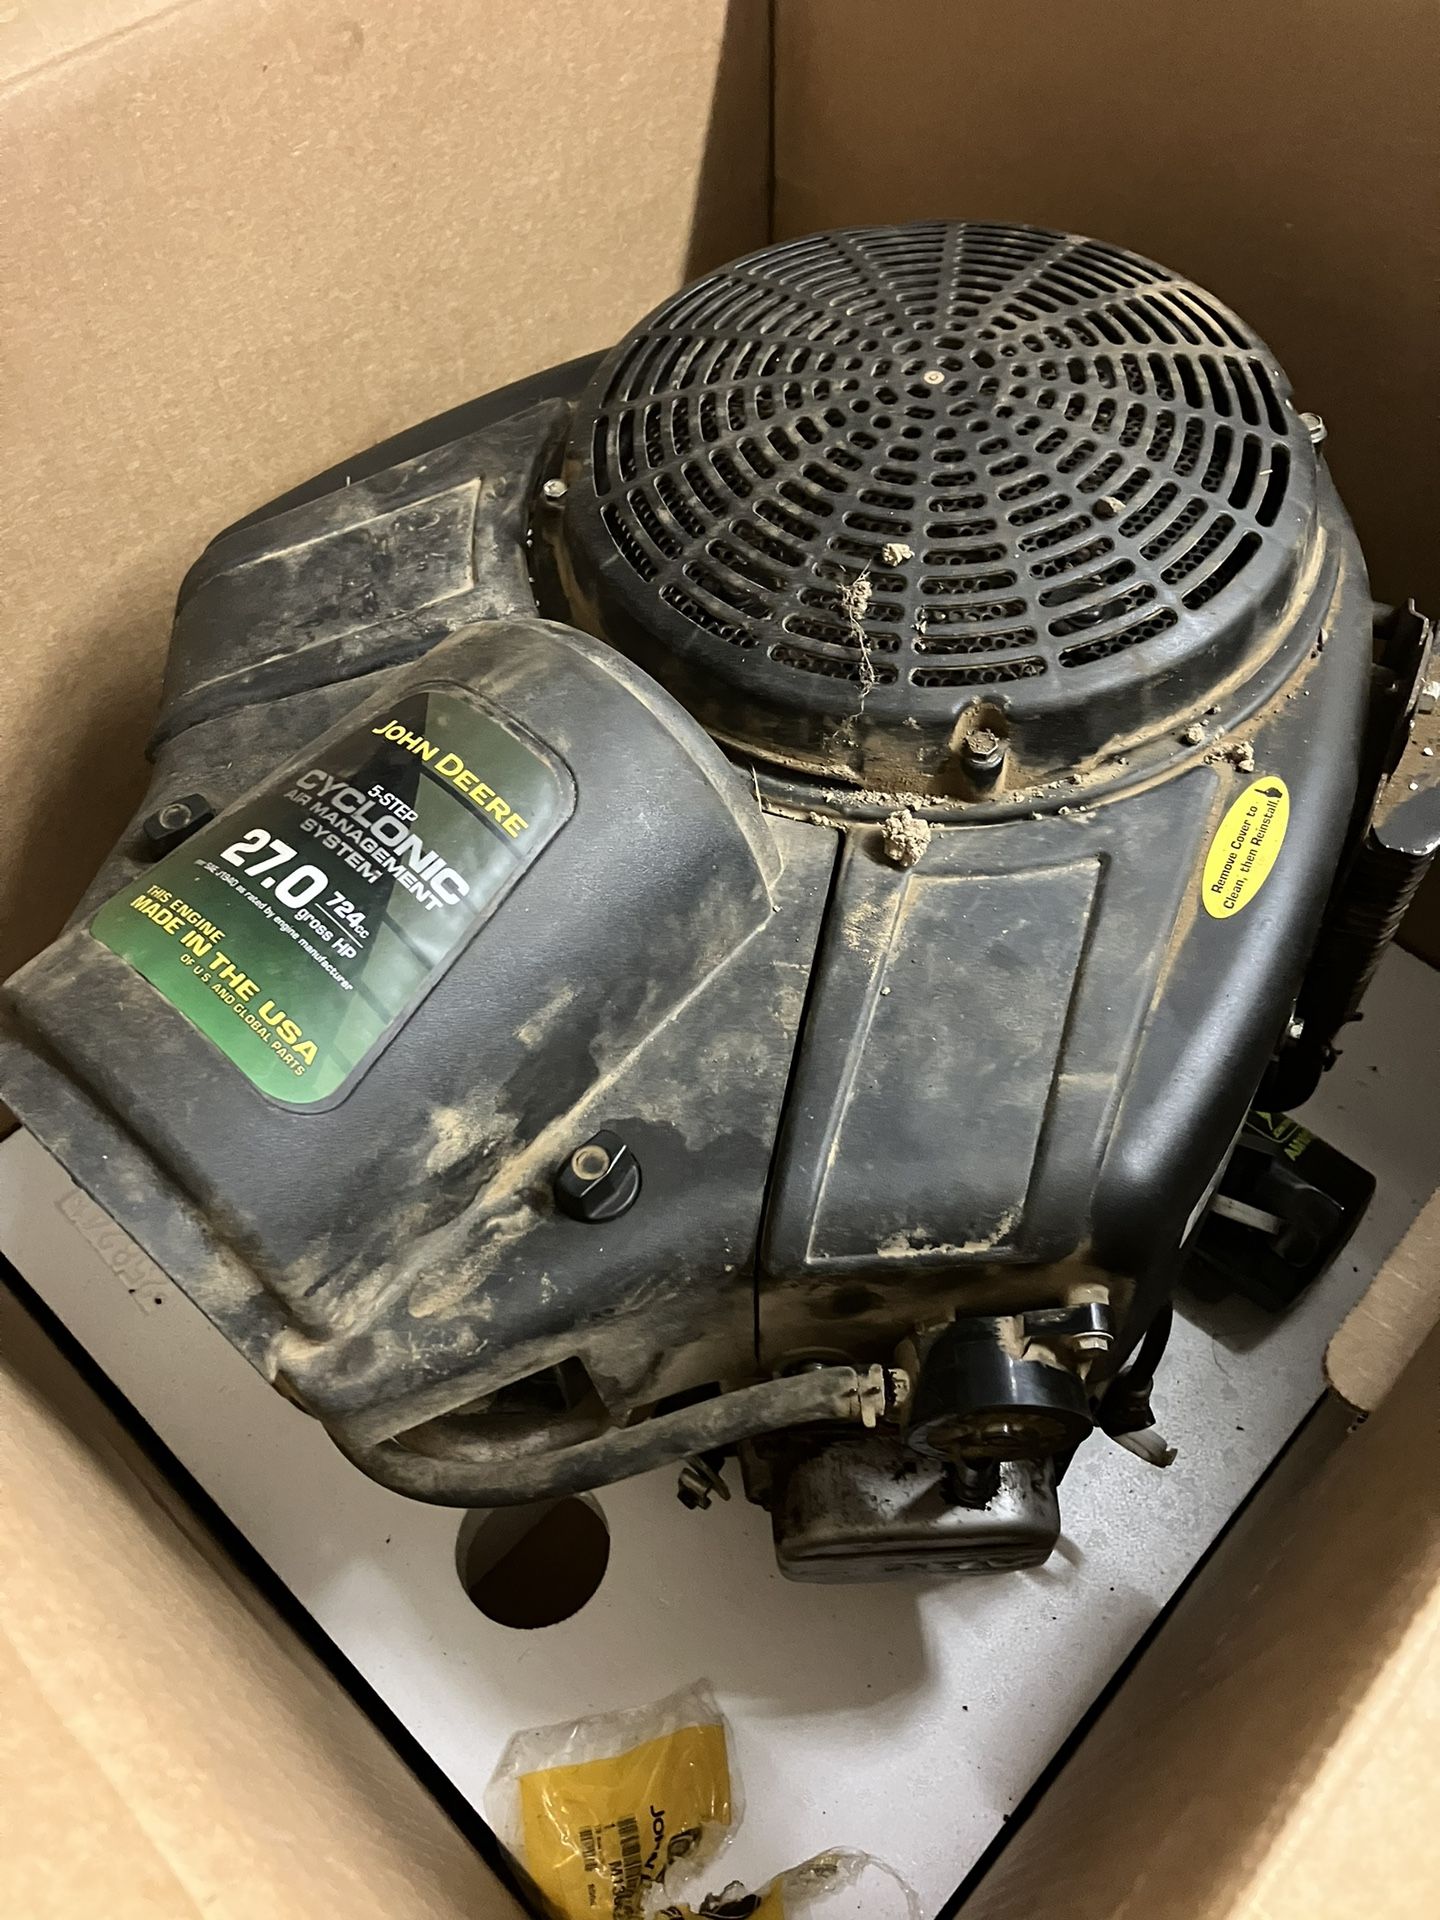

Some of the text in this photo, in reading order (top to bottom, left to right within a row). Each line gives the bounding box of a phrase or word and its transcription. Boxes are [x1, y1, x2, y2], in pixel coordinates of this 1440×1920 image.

[367, 784, 419, 823] 5-STEP
[372, 720, 529, 838] JOHN DEERE
[220, 828, 329, 909] 27.0
[284, 790, 443, 911] AIR MANAGEMENT
[296, 769, 470, 905] CYCLONIC
[300, 818, 383, 884] SYSTEM
[1211, 806, 1258, 893] Remove Cover to
[1223, 800, 1280, 909] Clean, then Reinstall.
[146, 885, 226, 944] THIS ENGINE
[244, 892, 268, 911] rated
[263, 906, 276, 919] by
[273, 916, 300, 940] engine
[298, 938, 354, 991] manufacturer
[294, 908, 357, 958] gross HP
[130, 895, 319, 1066] MADE IN THE USA
[180, 953, 195, 966] OF
[211, 983, 236, 1005] AND
[233, 1003, 272, 1042] GLOBAL
[270, 1041, 306, 1076] PARTS
